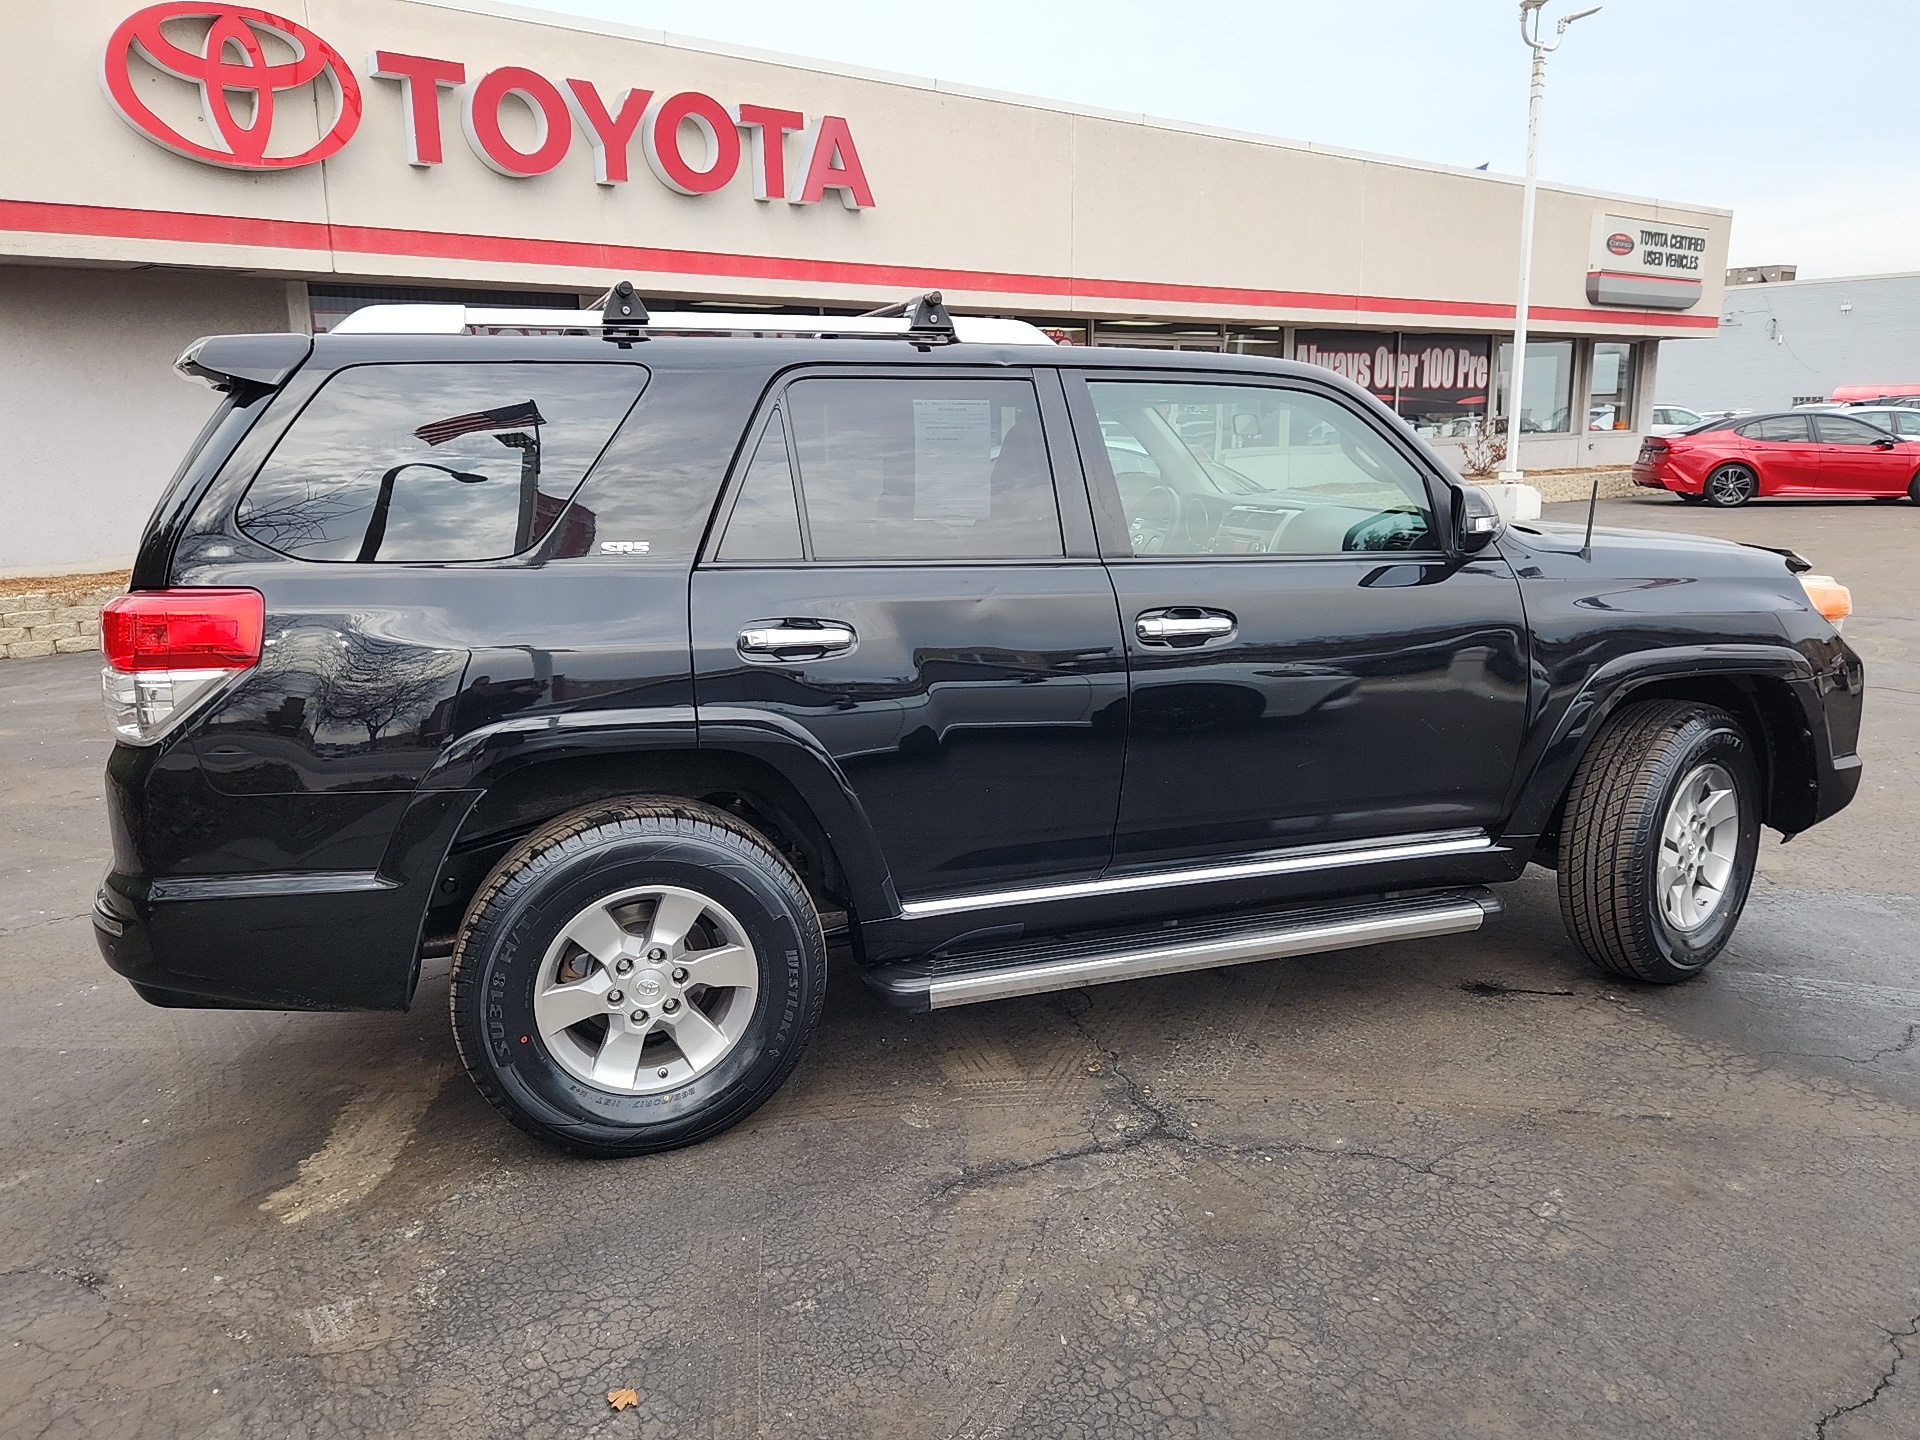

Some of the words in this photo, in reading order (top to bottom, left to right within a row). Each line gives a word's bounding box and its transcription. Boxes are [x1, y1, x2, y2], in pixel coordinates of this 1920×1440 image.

[368, 50, 875, 209] TOYOTA
[1640, 230, 1668, 248] TOYOTA
[1670, 234, 1706, 252] CERTIFIED
[1643, 250, 1664, 266] USED
[1665, 252, 1699, 270] VEHICLES
[1373, 346, 1419, 390] Over
[1421, 348, 1456, 390] 100
[1458, 349, 1488, 390] Pre
[601, 541, 650, 555] SR5
[500, 913, 531, 964] H/T
[489, 971, 512, 1057] SU318
[775, 949, 800, 1045] WESTLAKE
